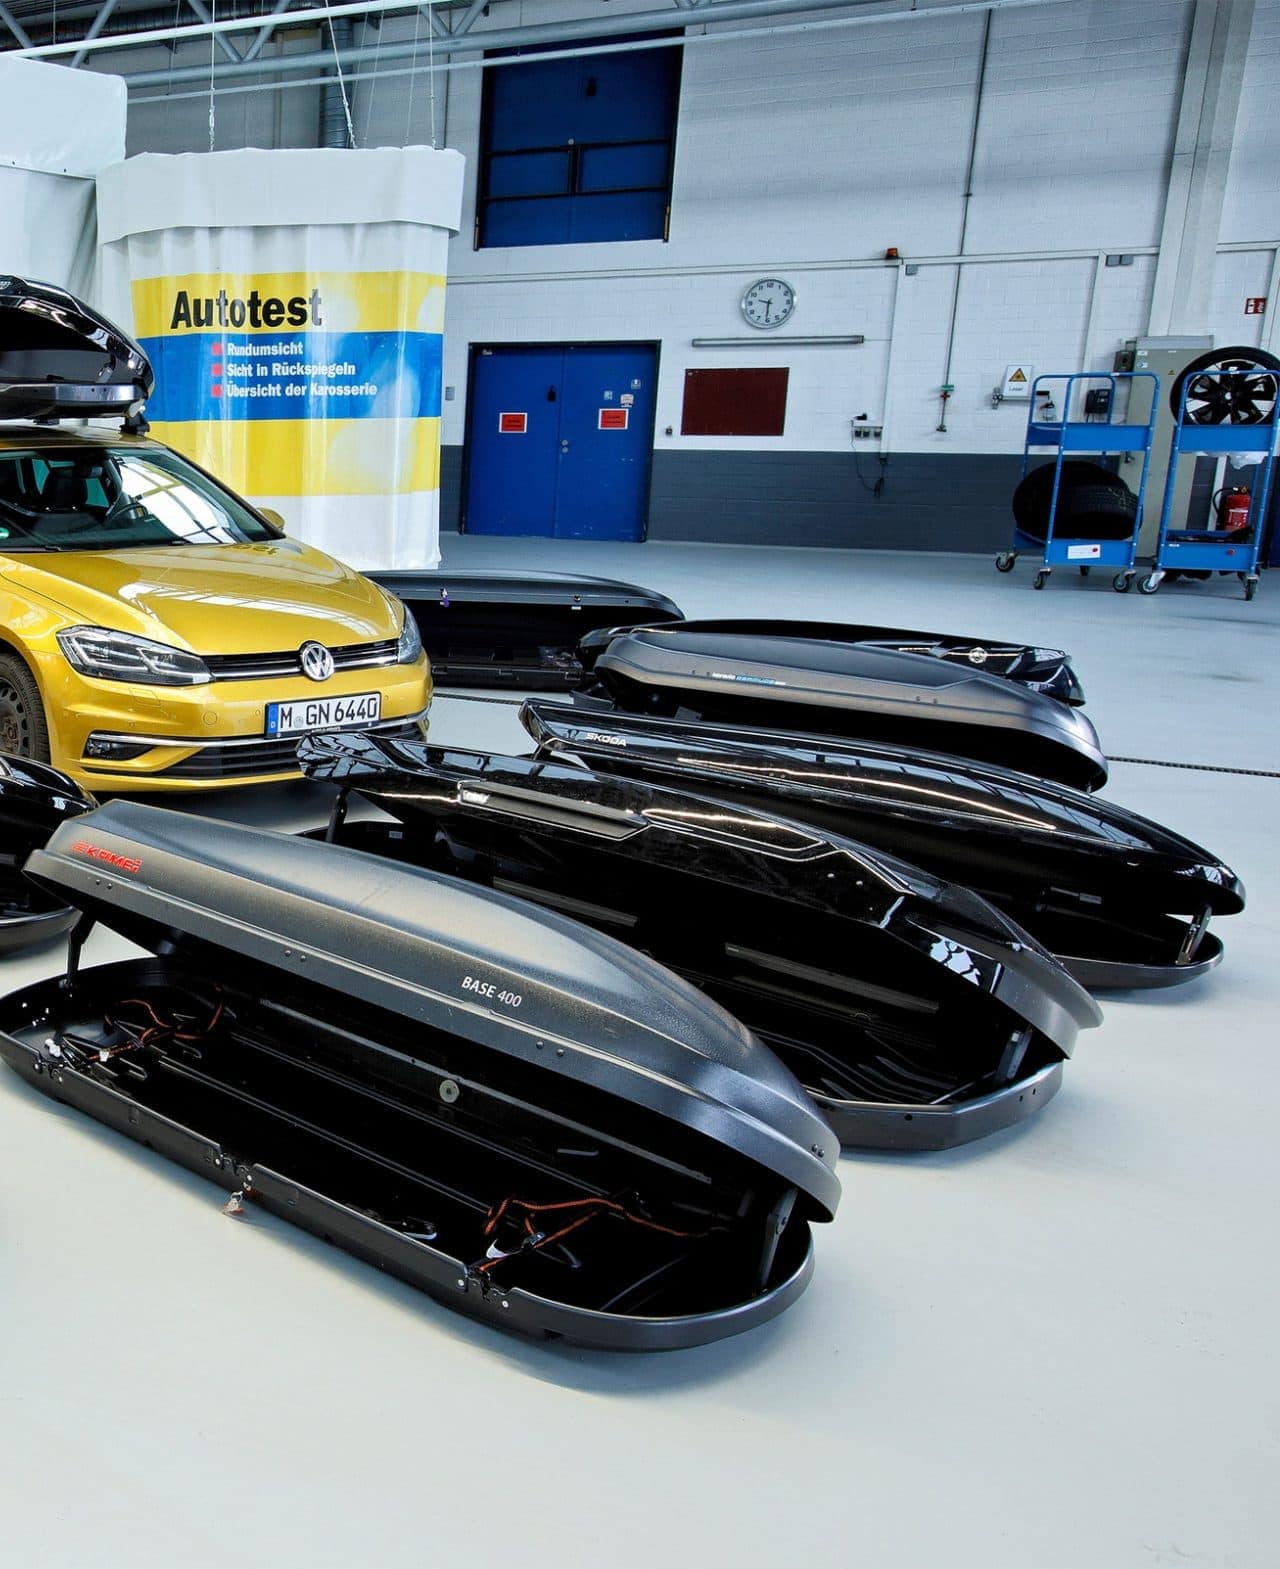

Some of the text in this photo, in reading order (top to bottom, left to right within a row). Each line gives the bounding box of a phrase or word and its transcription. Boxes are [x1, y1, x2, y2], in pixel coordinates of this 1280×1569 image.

[170, 289, 322, 330] Autotest
[227, 341, 304, 356] Rundumsicht
[227, 362, 356, 377] Sicht in Rückspiegeln
[227, 381, 378, 397] Übersicht der Karosserie
[280, 697, 378, 728] M GN 6440
[461, 976, 522, 1008] BASE 400
